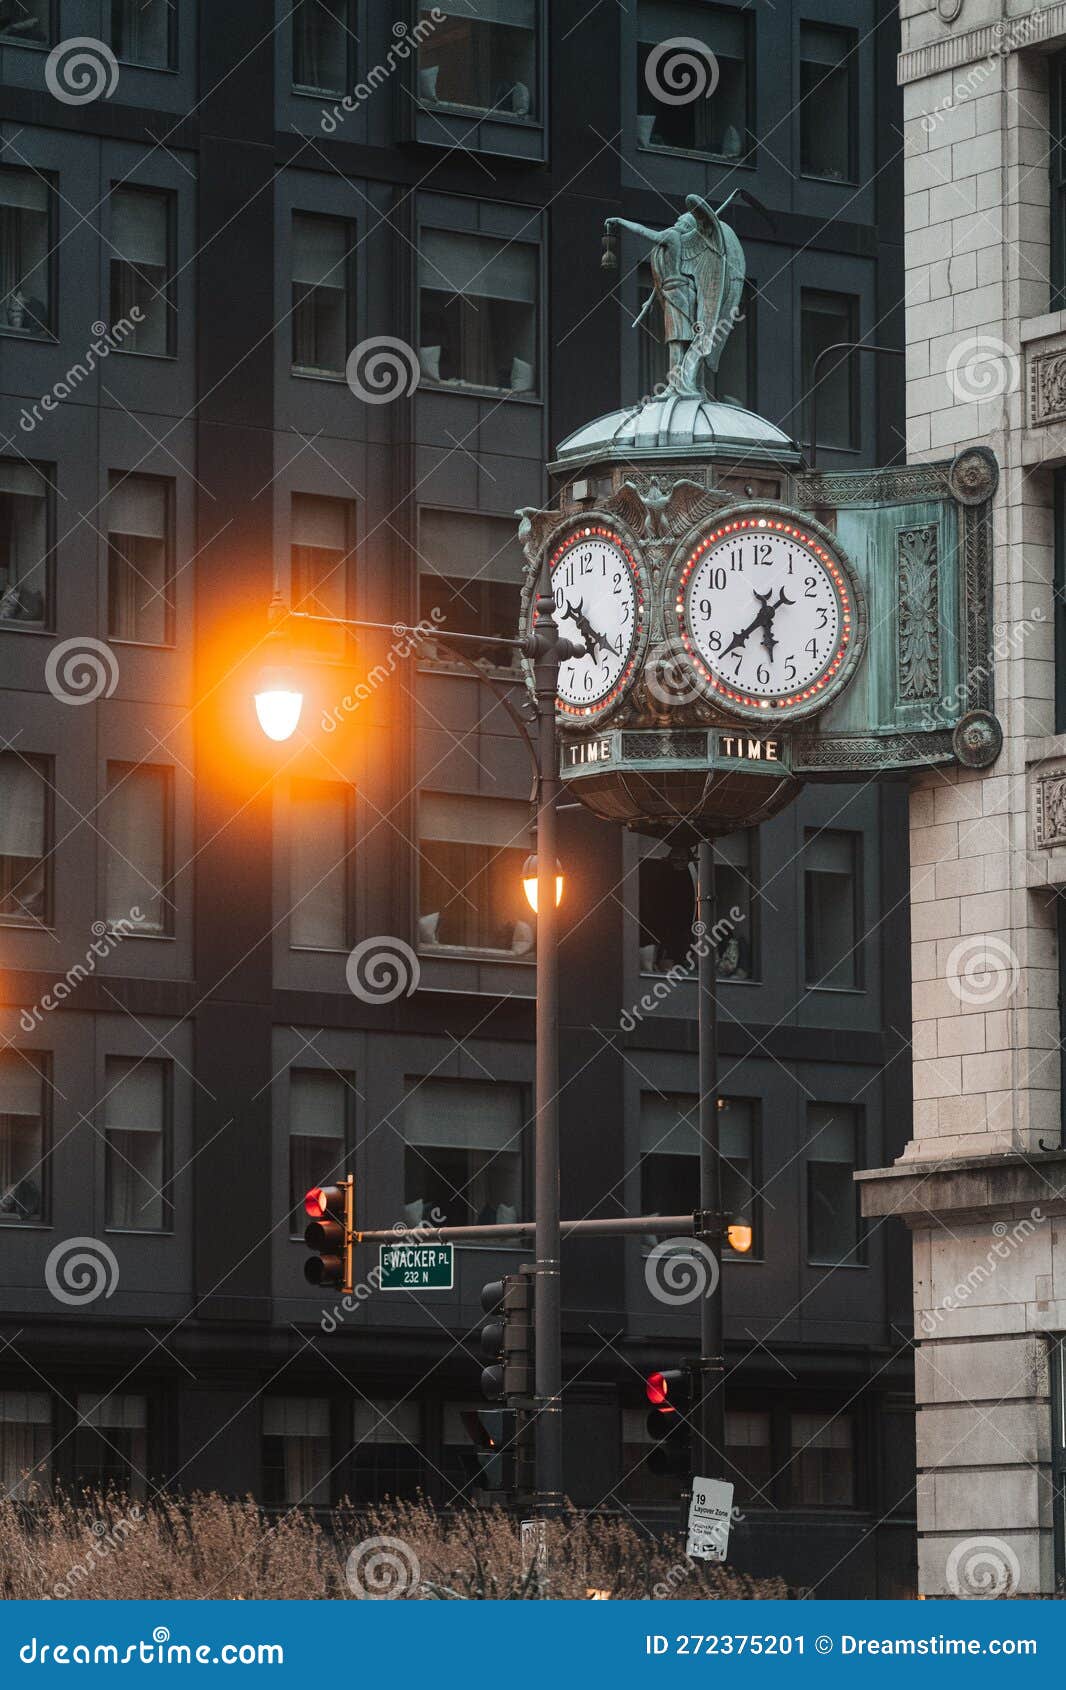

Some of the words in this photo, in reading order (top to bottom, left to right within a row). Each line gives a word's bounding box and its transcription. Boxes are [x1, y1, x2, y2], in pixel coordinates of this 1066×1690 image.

[580, 552, 593, 575] 12
[731, 547, 744, 572] 11
[753, 544, 774, 566] 12
[787, 552, 793, 575] 1
[565, 562, 574, 587] 11
[612, 572, 622, 594] 2
[708, 567, 727, 590] 10
[804, 576, 818, 598] 2
[620, 600, 630, 625] 3
[699, 599, 712, 621] 9
[815, 607, 828, 630] 3
[614, 633, 624, 655] 4
[708, 630, 722, 651] 8
[804, 638, 819, 659] 4
[601, 655, 610, 683] 5
[731, 651, 743, 676] 7
[756, 663, 770, 685] 6
[784, 655, 797, 681] 5
[567, 666, 575, 689] 7
[583, 670, 593, 692] 6
[570, 740, 610, 765] TIME
[722, 737, 778, 761] TIME
[383, 1253, 390, 1266] E
[390, 1250, 436, 1268] WACKER
[438, 1252, 449, 1265] PL
[404, 1271, 420, 1283] 232
[422, 1271, 429, 1283] N
[694, 1504, 715, 1516] Layover
[715, 1508, 729, 1518] Zone
[696, 1494, 706, 1506] 19
